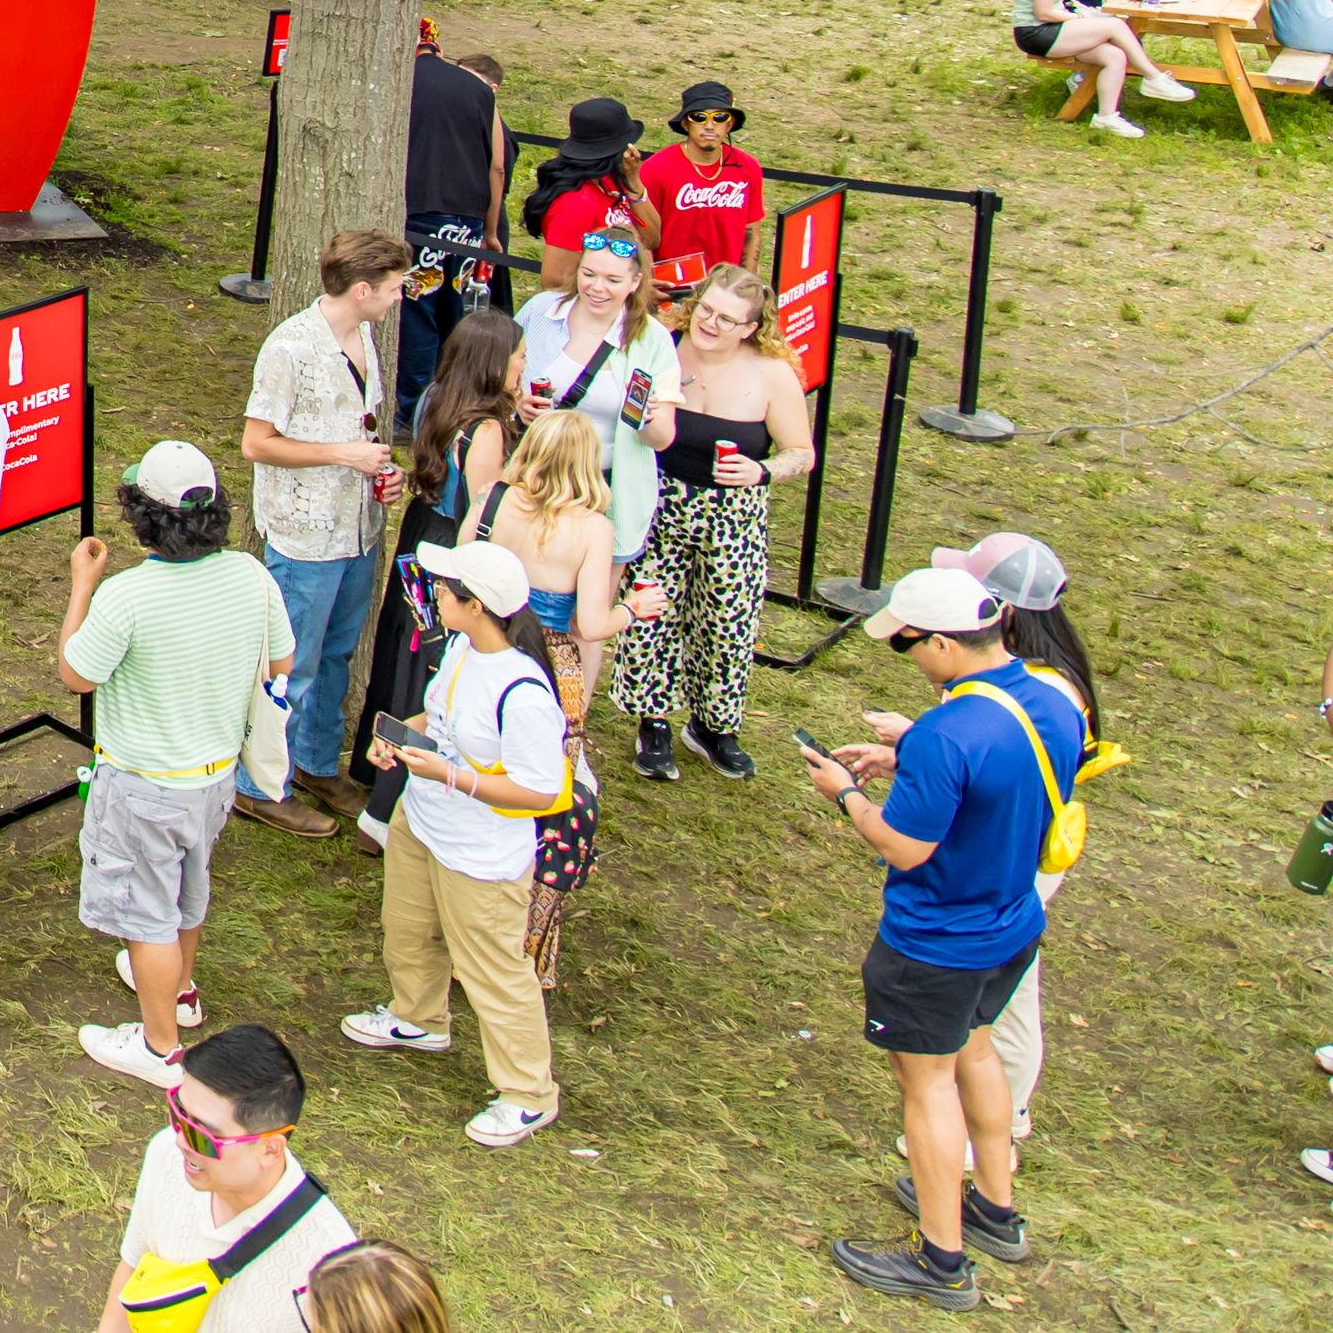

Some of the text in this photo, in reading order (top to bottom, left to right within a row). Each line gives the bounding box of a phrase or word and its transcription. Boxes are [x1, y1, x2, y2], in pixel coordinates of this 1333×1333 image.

[675, 181, 748, 210] Coca-Cola
[778, 270, 828, 308] ENTER HERE
[23, 383, 70, 412] HERE
[5, 432, 37, 450] ca-Cola!
[9, 416, 59, 438] mplimentary
